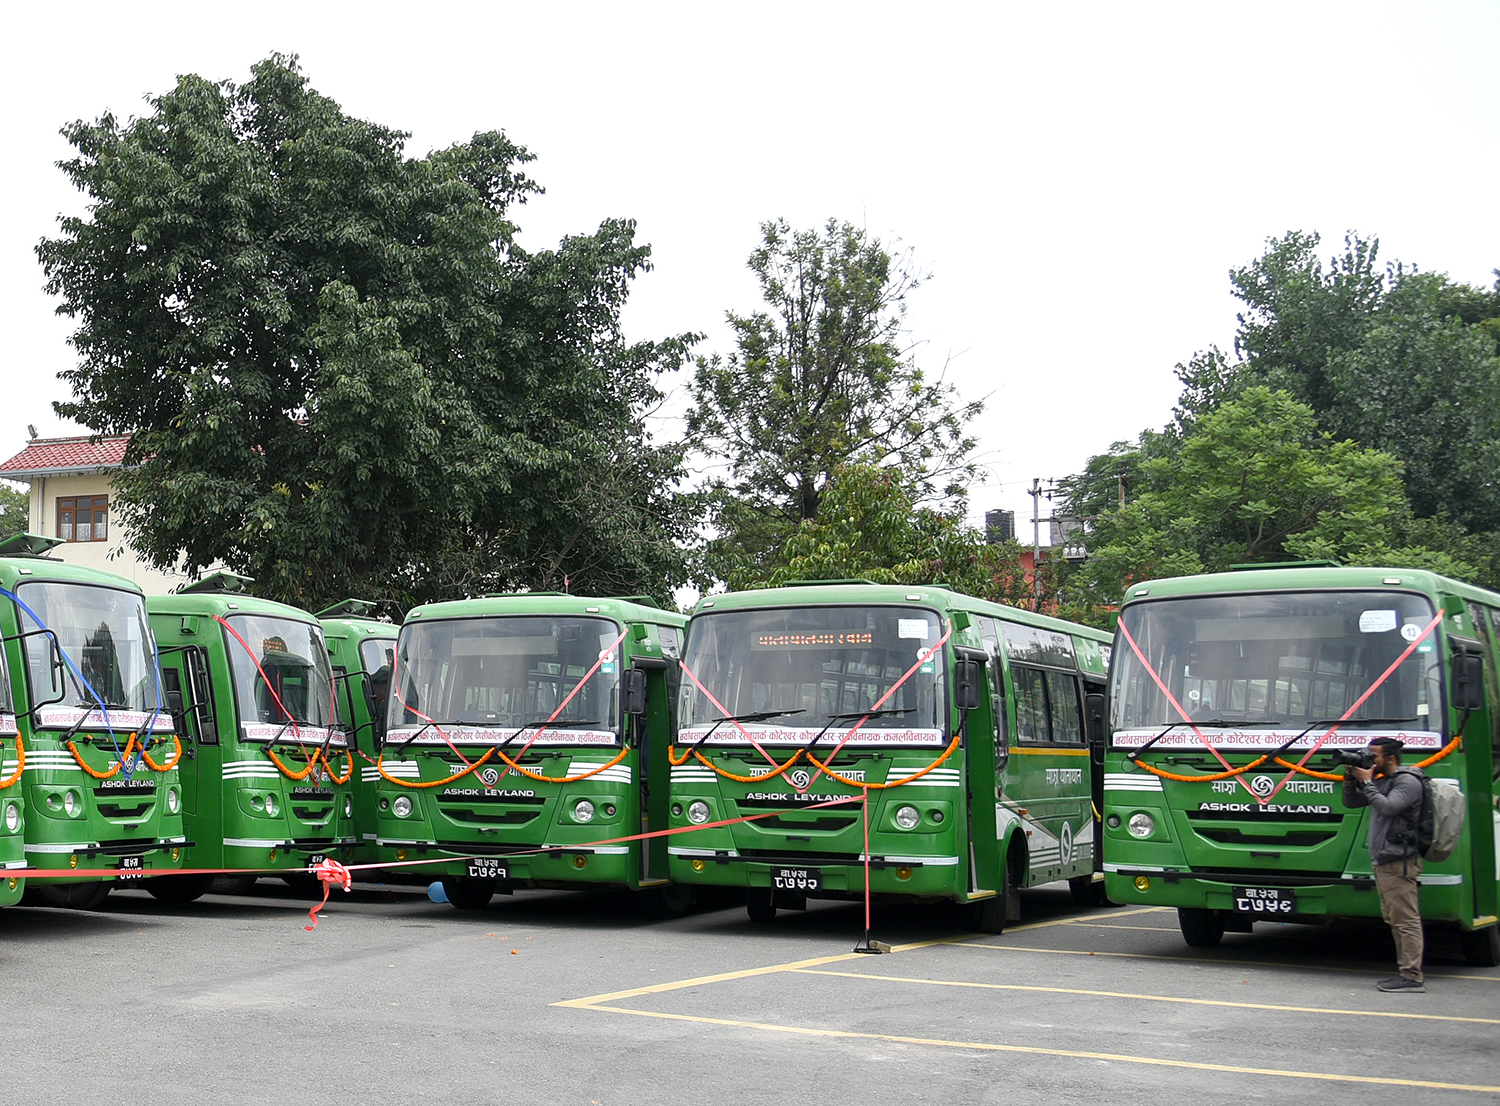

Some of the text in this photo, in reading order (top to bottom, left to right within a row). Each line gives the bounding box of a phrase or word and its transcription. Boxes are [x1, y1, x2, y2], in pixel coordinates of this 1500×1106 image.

[1406, 627, 1417, 637] 13
[101, 780, 126, 788] ASHOK
[1285, 781, 1335, 794] यातायात
[443, 788, 534, 797] ASHOK LEYLAND
[746, 792, 788, 800] ASHOK
[1199, 802, 1330, 814] ASHOK LEYLAND
